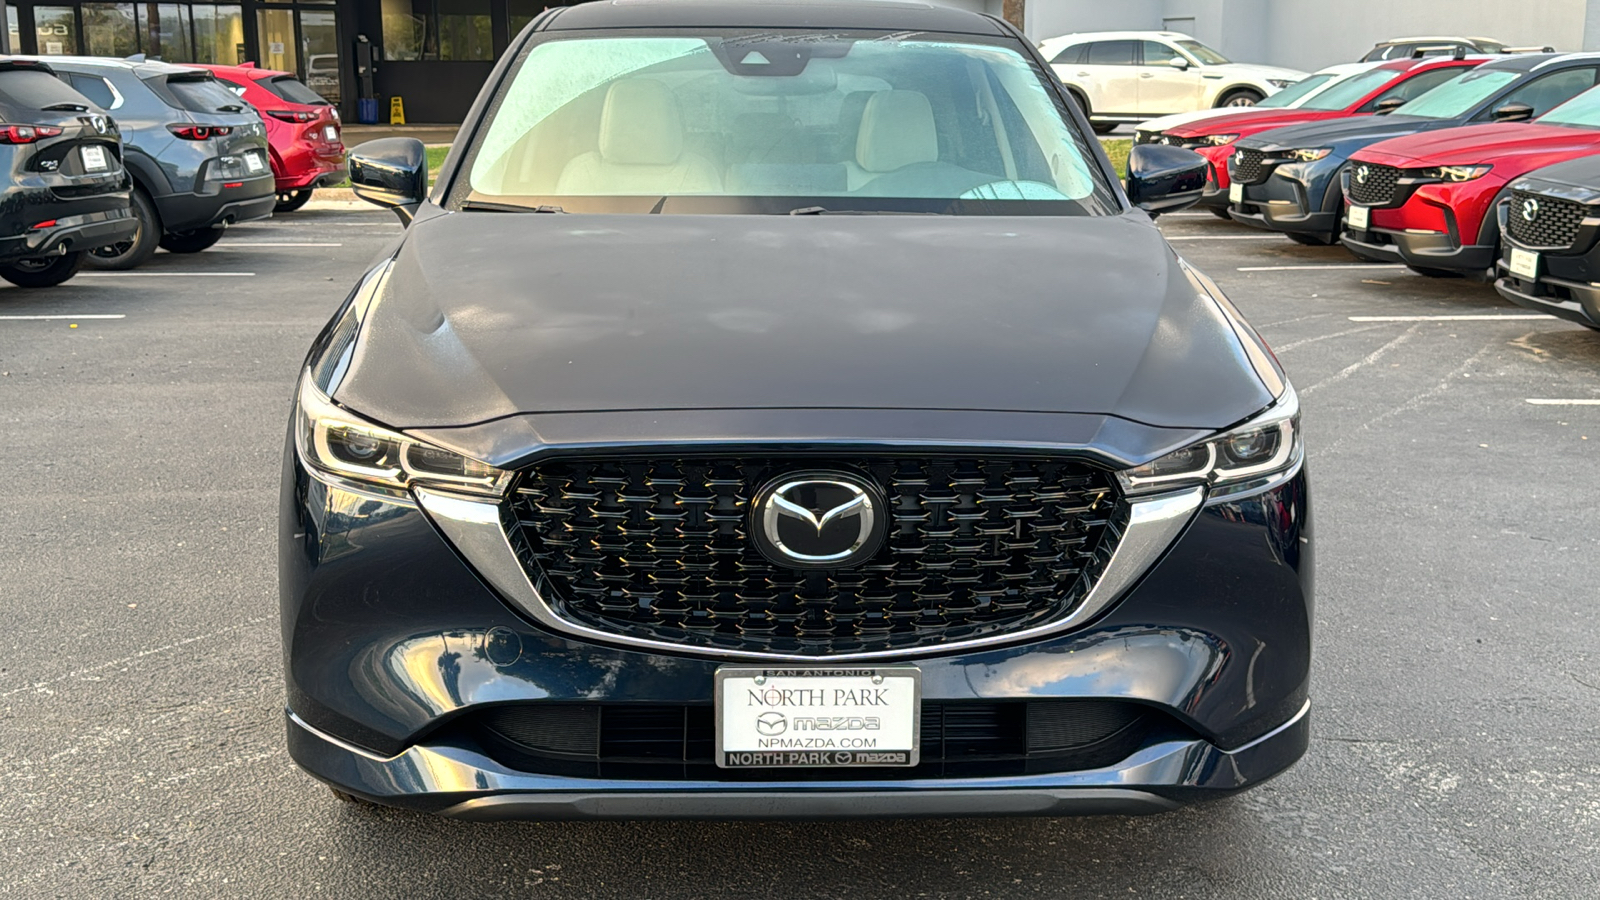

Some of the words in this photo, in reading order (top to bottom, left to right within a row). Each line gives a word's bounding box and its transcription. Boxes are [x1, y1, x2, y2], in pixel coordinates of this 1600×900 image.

[766, 669, 797, 677] SAN
[802, 669, 872, 677] ANTONIO
[747, 688, 825, 707] NORTH
[833, 688, 889, 706] PARK
[793, 716, 881, 731] mazda
[758, 737, 877, 748] NPMAZDA.COM
[729, 752, 784, 765] NORTH
[789, 752, 831, 764] PARK
[855, 752, 907, 763] mazda
